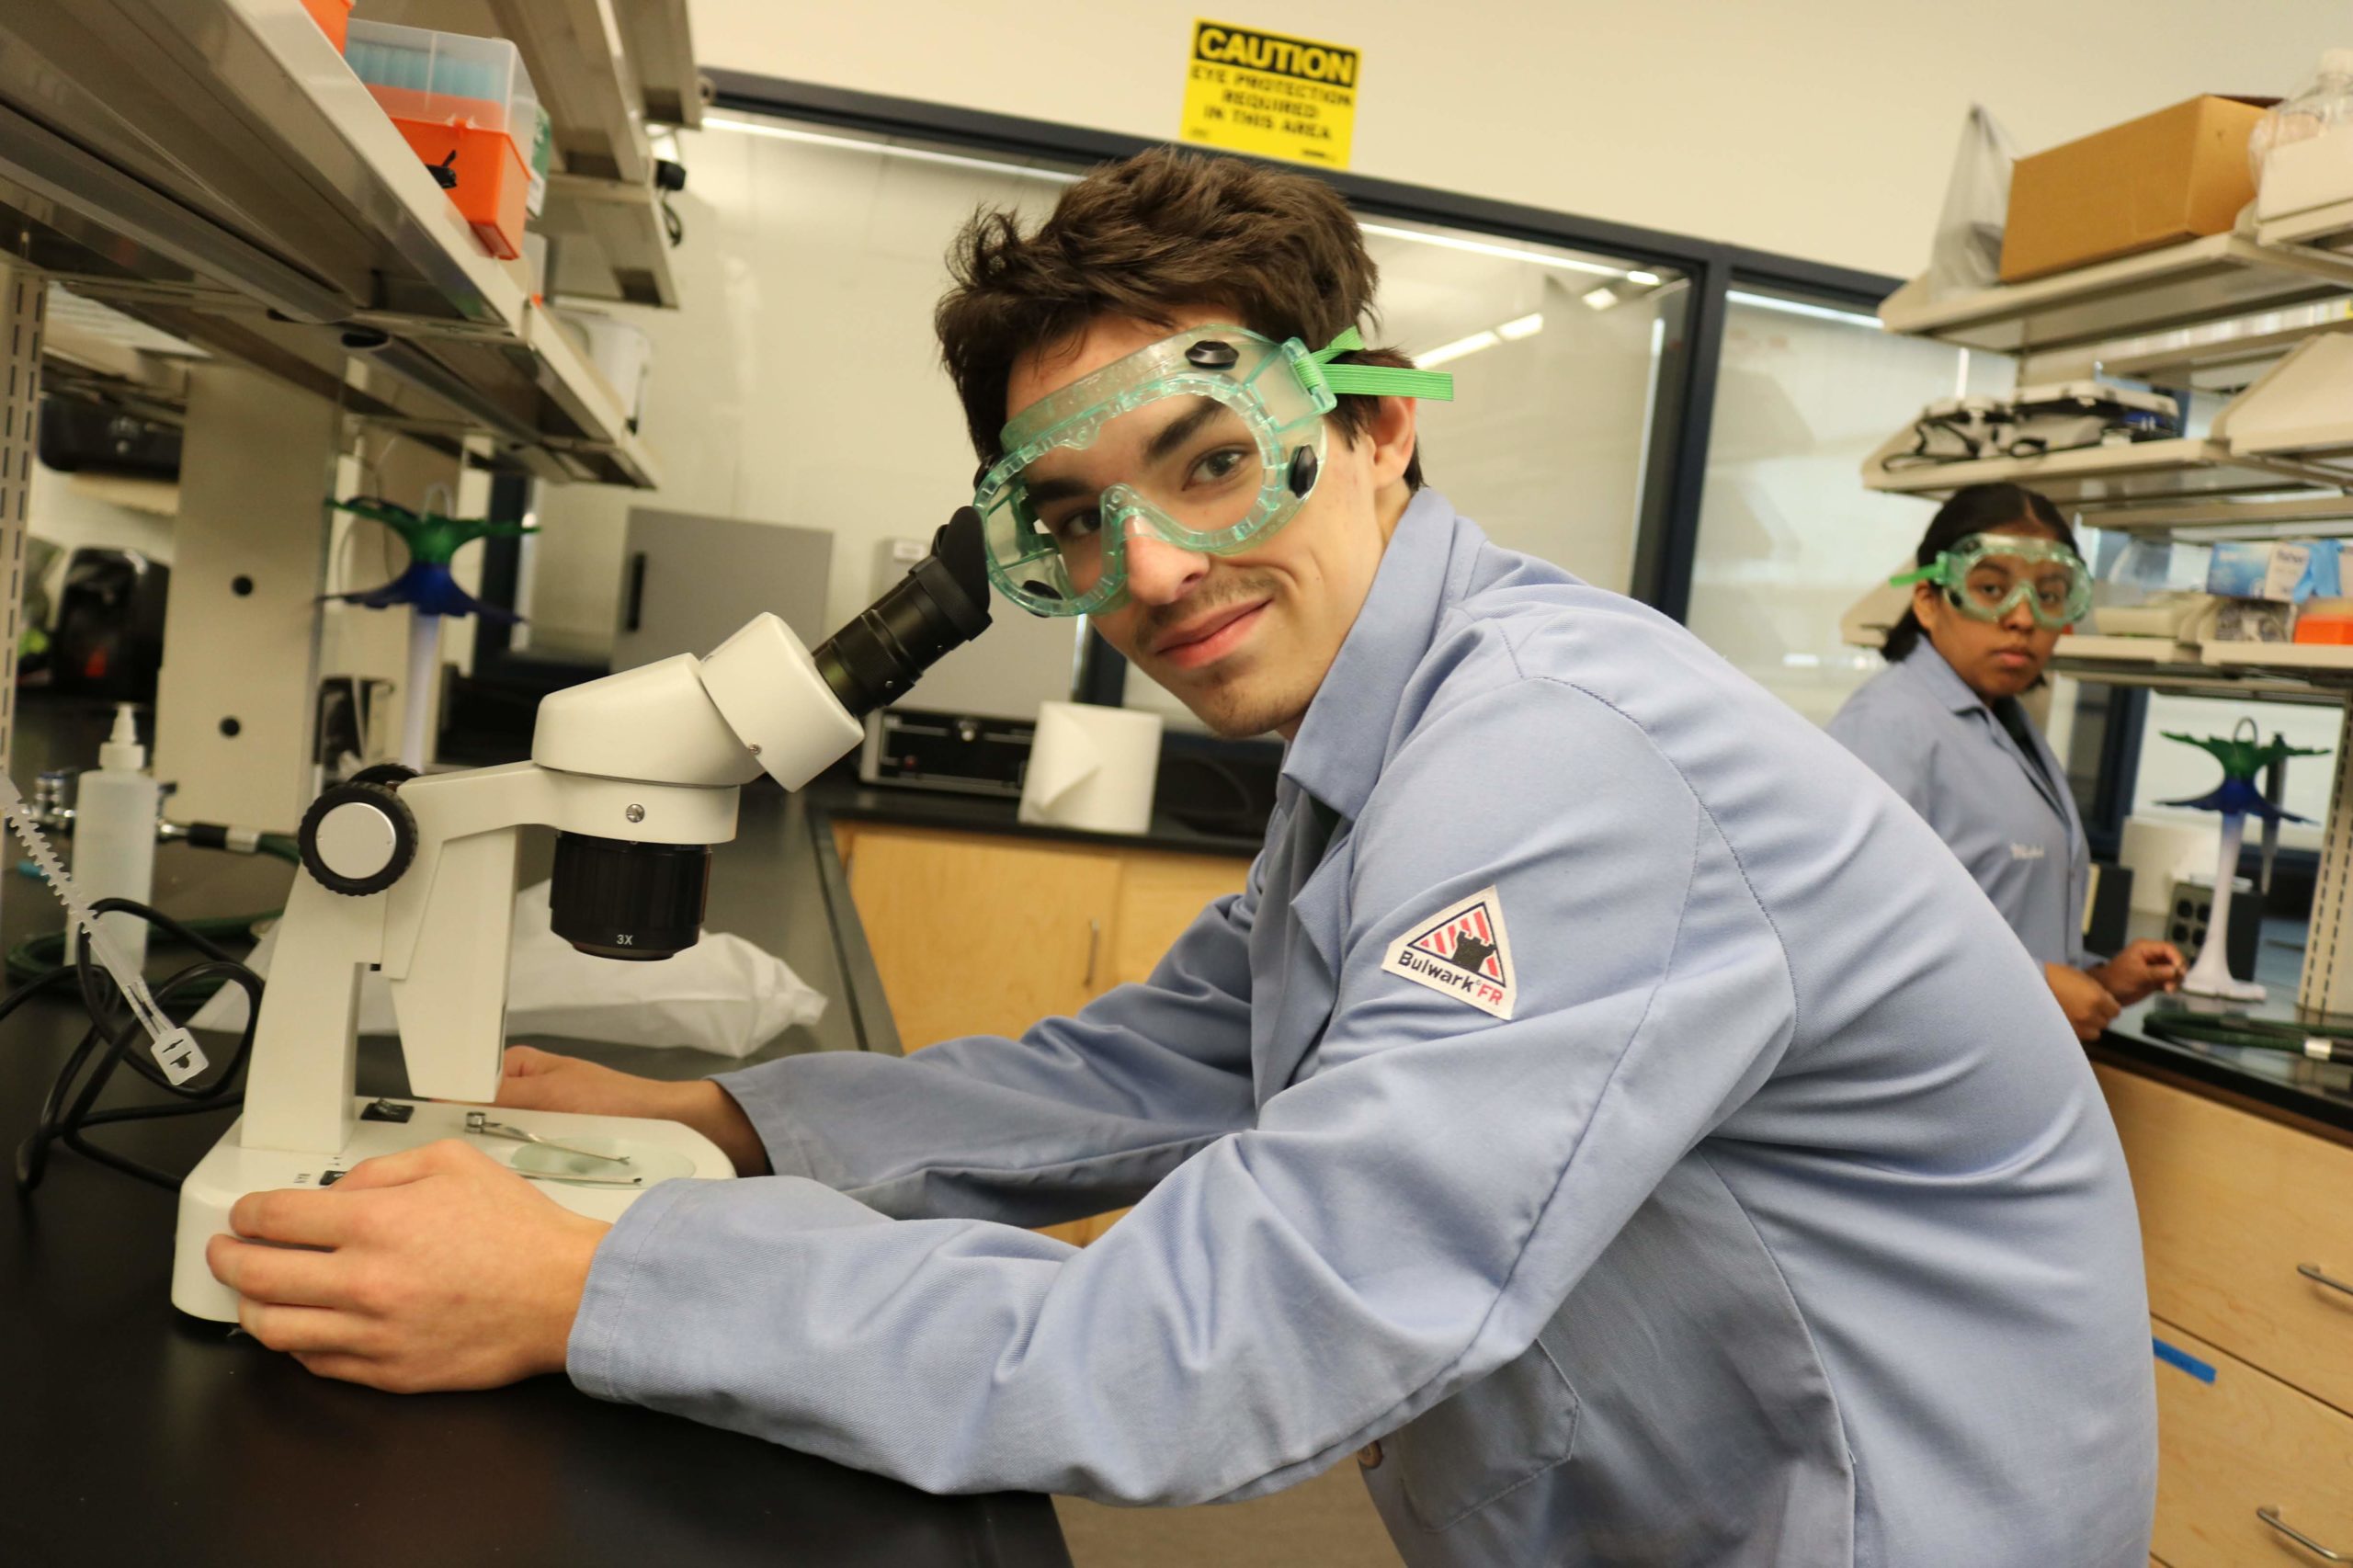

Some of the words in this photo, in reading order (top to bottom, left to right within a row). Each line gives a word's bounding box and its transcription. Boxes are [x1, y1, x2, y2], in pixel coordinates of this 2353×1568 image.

[1199, 28, 1354, 85] CAUTION
[1191, 64, 1227, 84] EYE
[1234, 73, 1352, 107] PROTECTION
[1222, 89, 1319, 119] REQUIRED
[1204, 106, 1224, 119] IN
[1233, 109, 1274, 131] THIS
[1281, 120, 1331, 140] AREA
[617, 934, 633, 945] 3X
[1398, 950, 1473, 993] Bulwark
[1477, 983, 1503, 1006] FR
